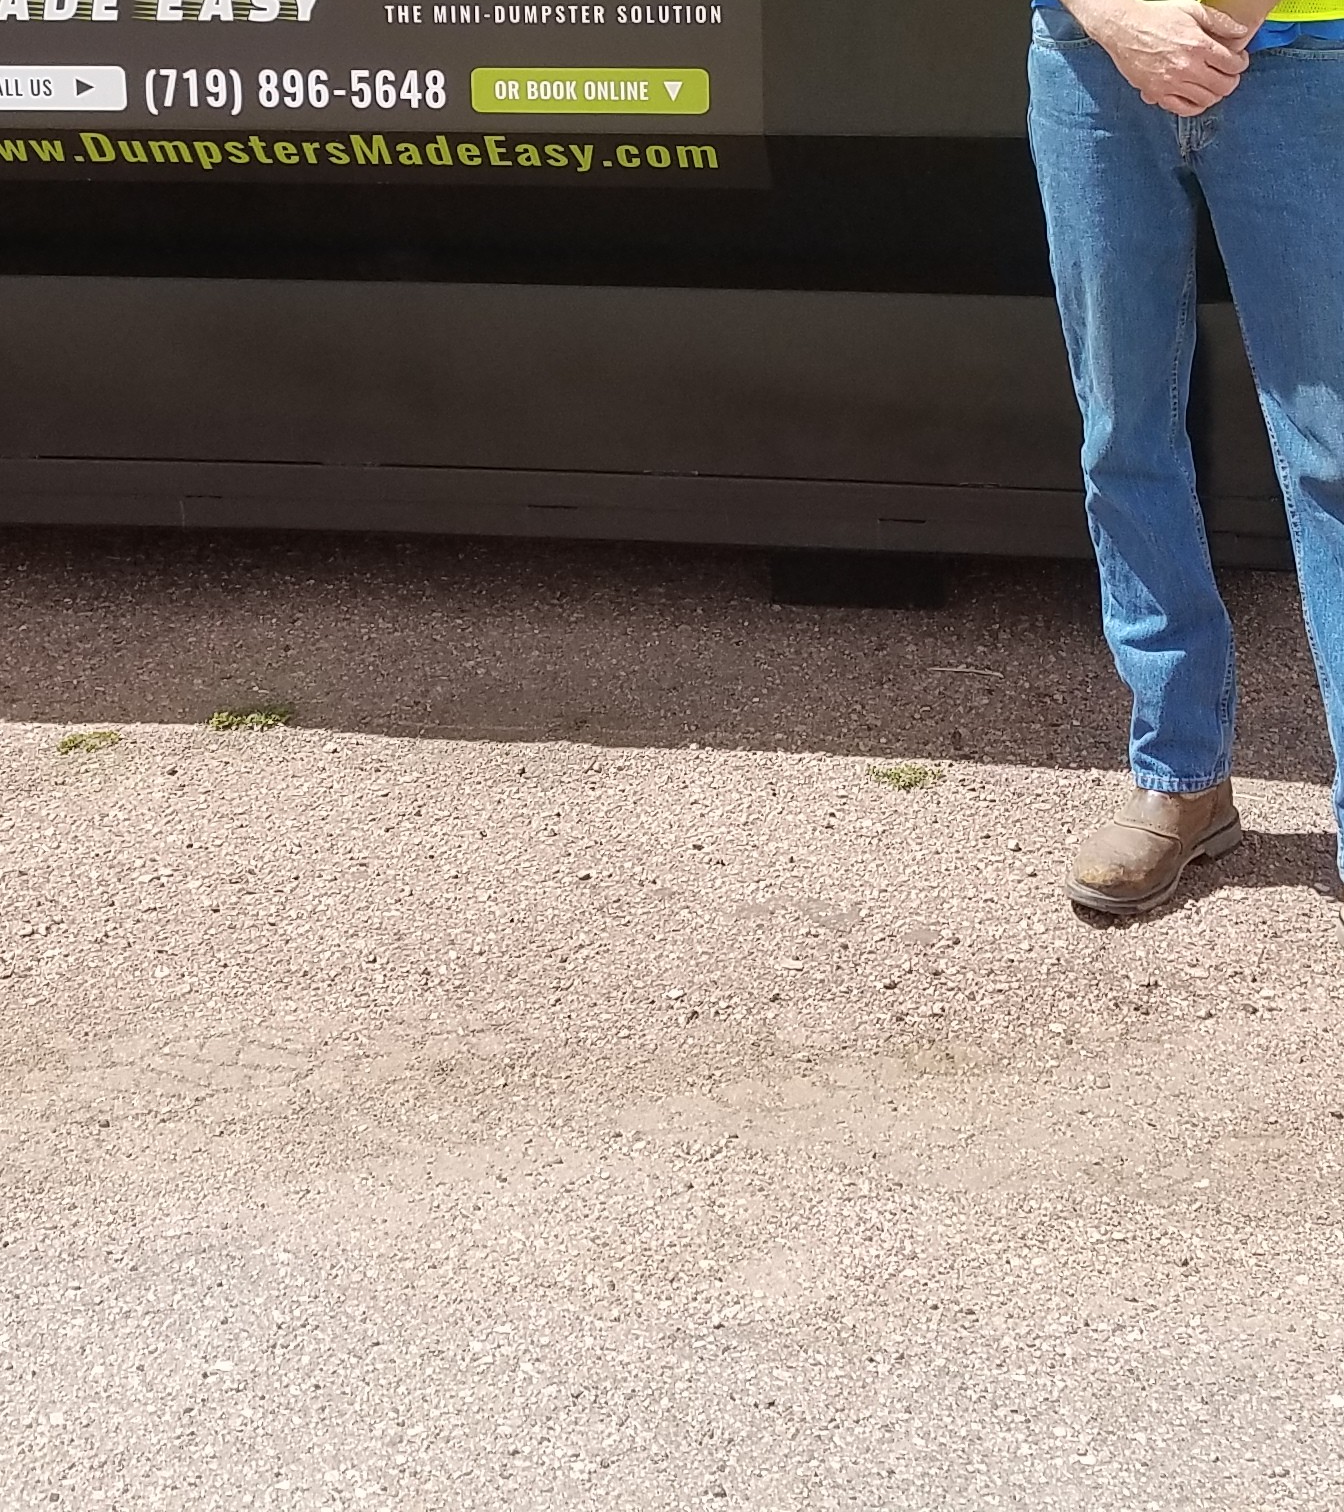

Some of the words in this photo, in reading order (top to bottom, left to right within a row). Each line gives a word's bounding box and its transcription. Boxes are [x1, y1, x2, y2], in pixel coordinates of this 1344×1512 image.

[384, 4, 422, 24] THE
[433, 5, 605, 24] MINI-DUMPSTER
[616, 5, 722, 24] SOLUTION
[30, 78, 53, 97] US
[145, 68, 243, 116] (719)
[258, 68, 446, 109] 896-5648
[494, 80, 520, 100] OR
[526, 80, 578, 101] BOOK
[584, 81, 649, 101] ONLINE
